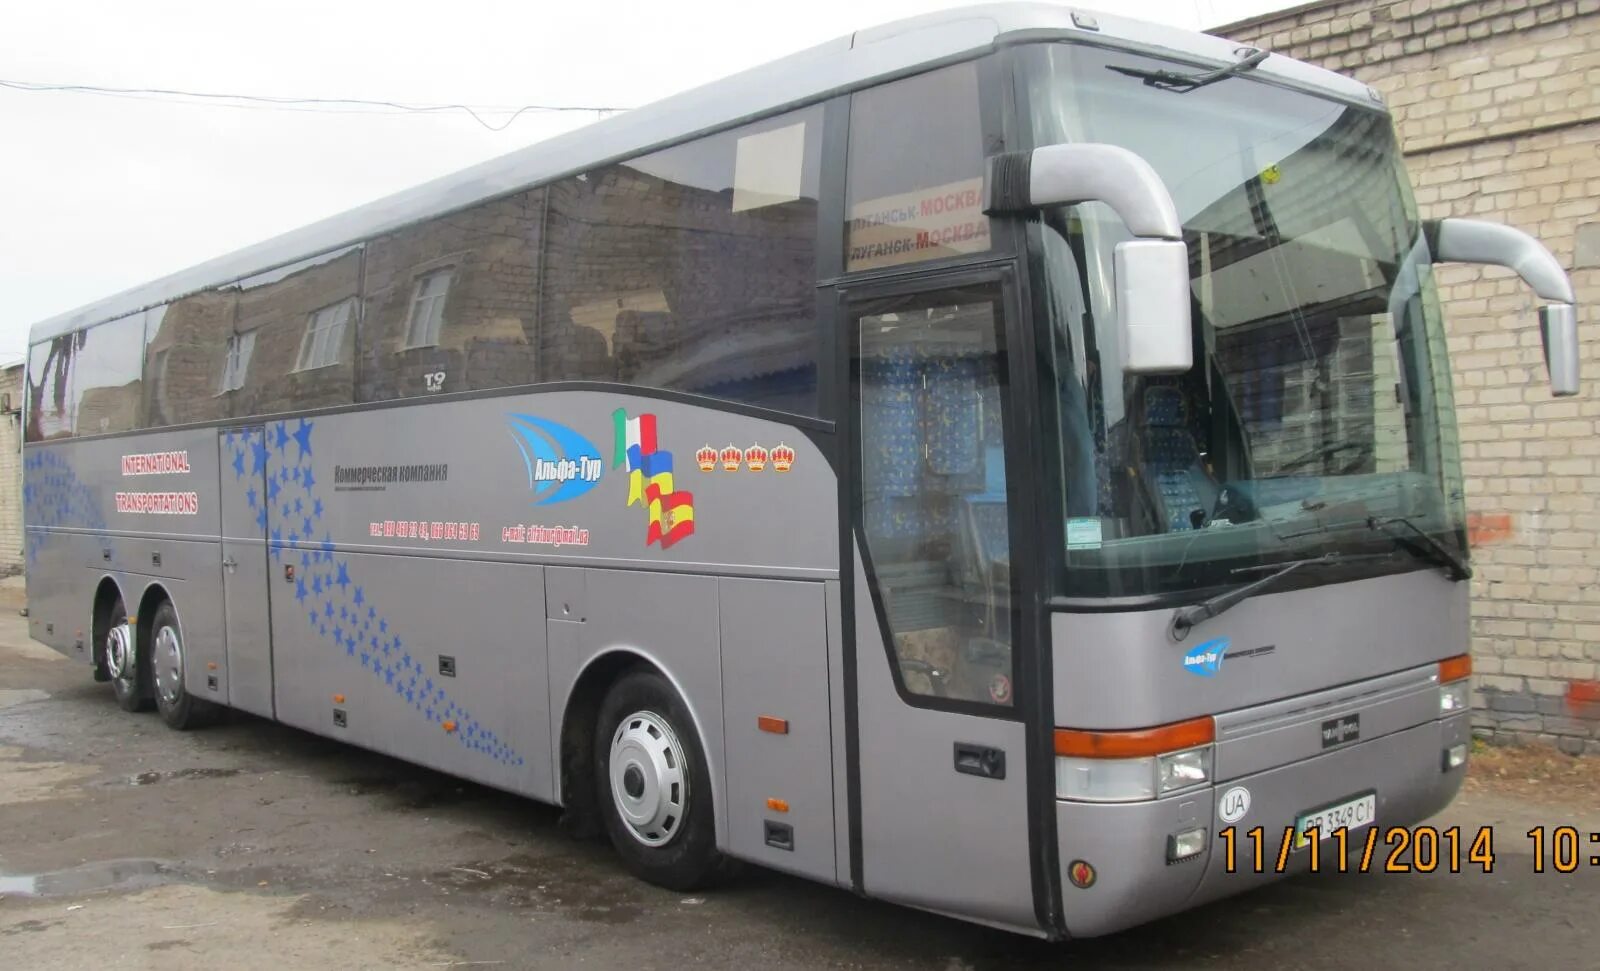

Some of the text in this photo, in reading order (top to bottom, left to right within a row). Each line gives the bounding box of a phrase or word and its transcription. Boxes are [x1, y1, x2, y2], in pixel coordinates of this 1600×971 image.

[424, 371, 446, 386] T9
[122, 451, 190, 475] INTERNATIONAL
[335, 464, 448, 484] Коммерческая компания
[535, 456, 601, 483] Альфа-Тур
[115, 491, 198, 515] TRANSPORTATIONS
[1225, 794, 1245, 816] UA
